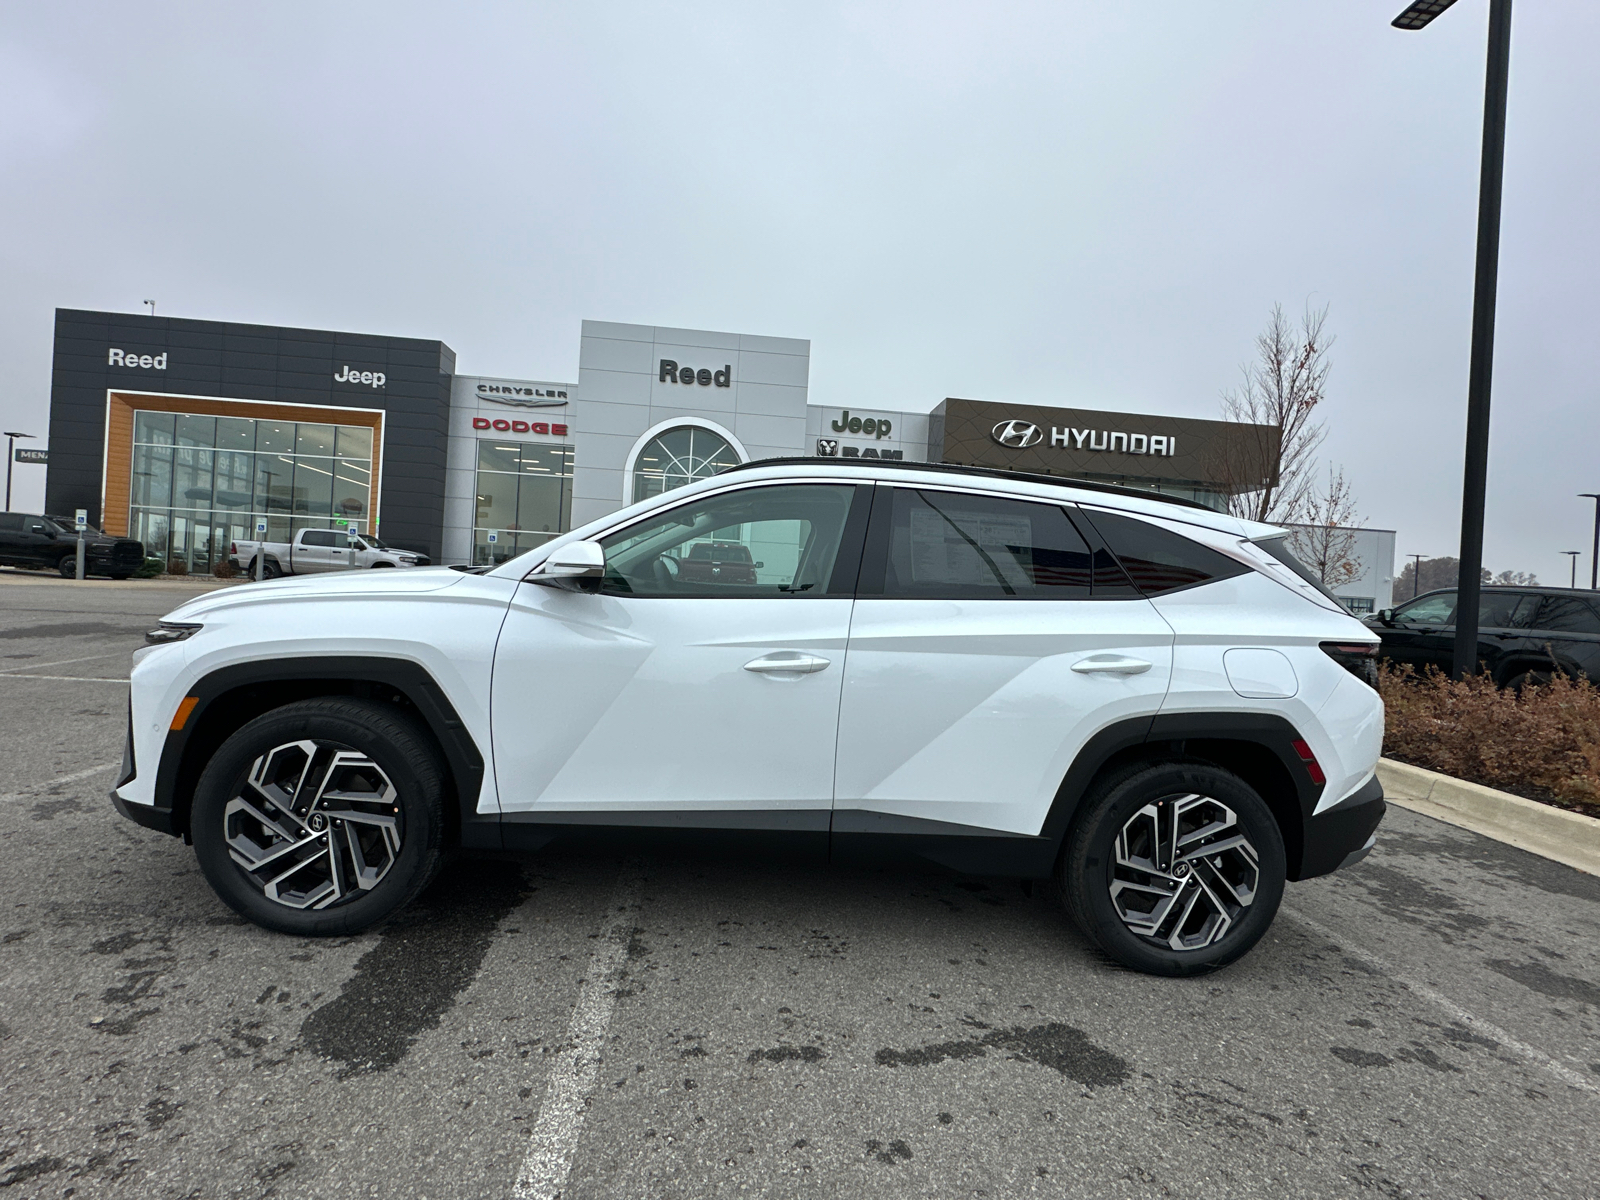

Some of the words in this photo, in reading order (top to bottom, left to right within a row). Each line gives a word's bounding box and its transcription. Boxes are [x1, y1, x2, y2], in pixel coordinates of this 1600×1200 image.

[108, 348, 168, 370] Reed
[334, 365, 386, 388] Jeep
[659, 359, 732, 388] Reed
[476, 384, 568, 399] CHRYSLER
[472, 417, 568, 436] DODGE
[831, 410, 892, 440] Jeep
[1050, 426, 1176, 457] HYUNDAI
[842, 446, 904, 460] RAM
